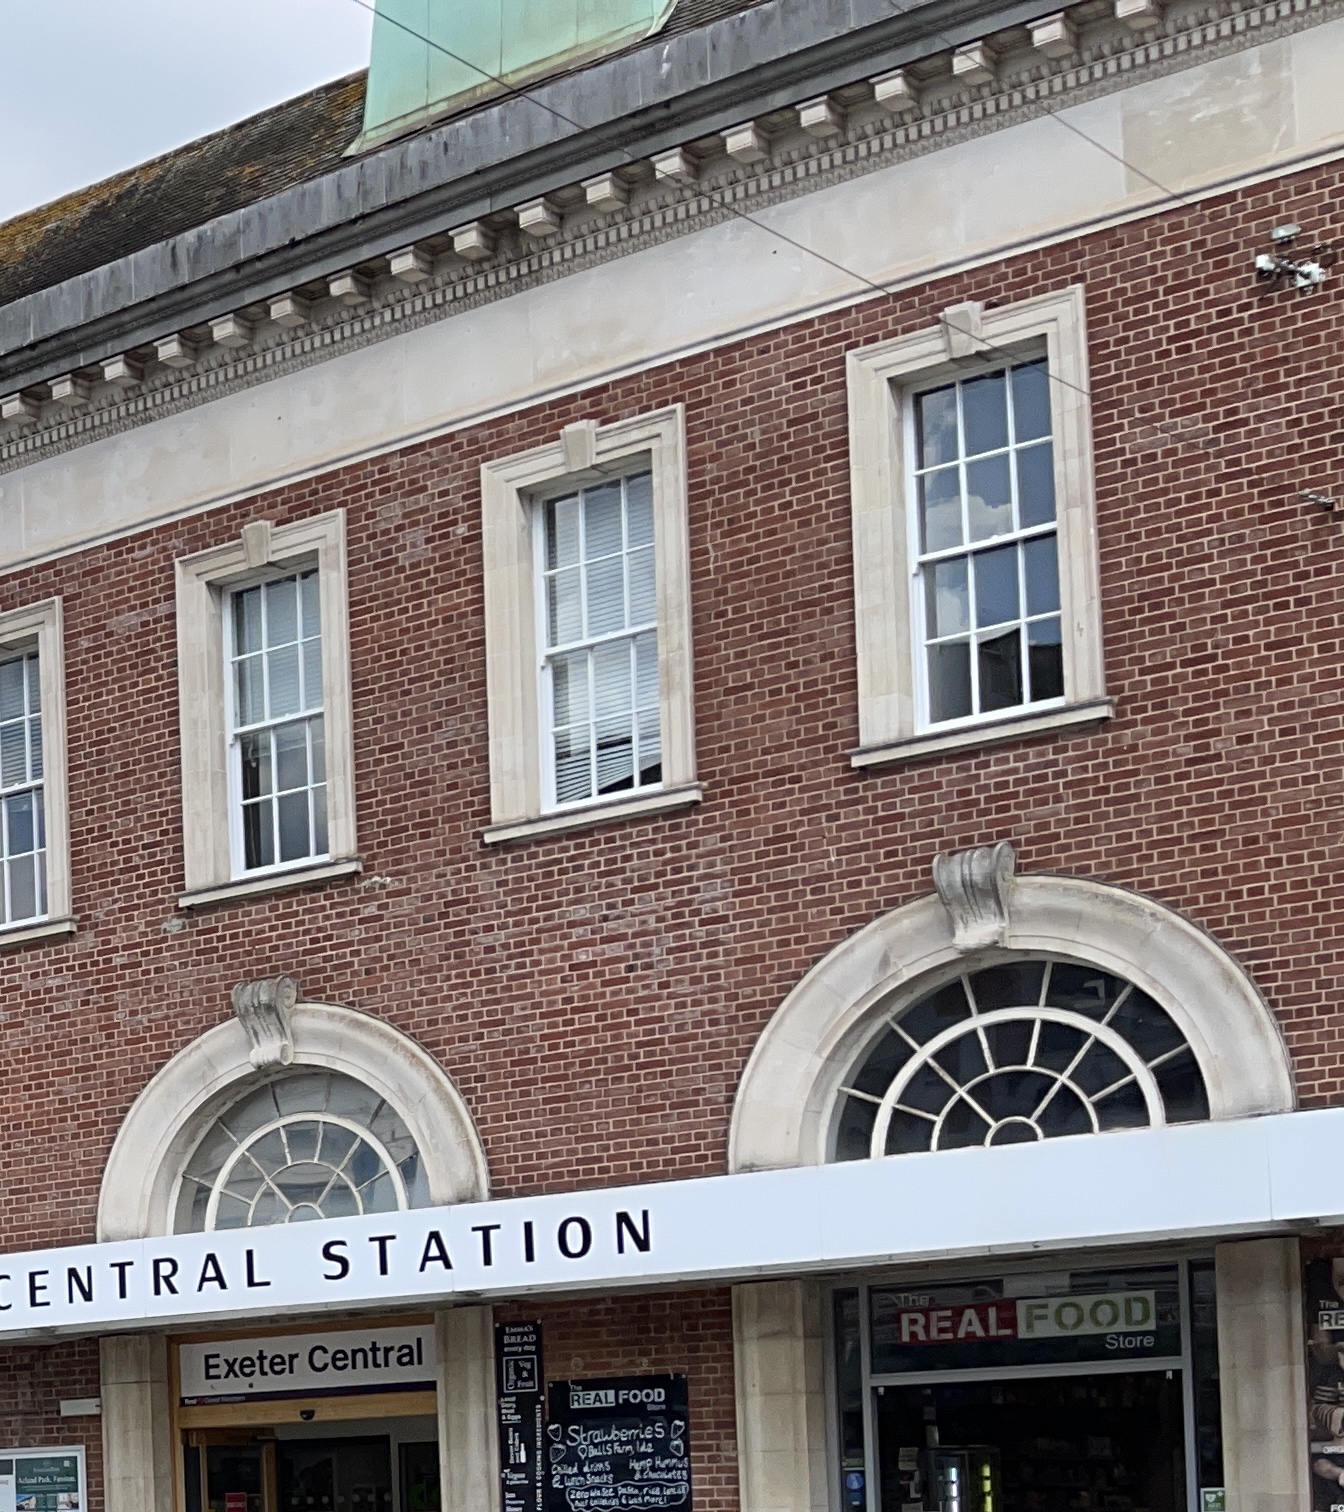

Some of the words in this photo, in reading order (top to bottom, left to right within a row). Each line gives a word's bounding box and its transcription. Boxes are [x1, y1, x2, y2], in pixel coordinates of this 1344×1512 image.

[321, 1209, 651, 1281] STATION
[900, 1306, 1013, 1343] REAL
[1025, 1296, 1151, 1334] FOOD
[503, 1334, 537, 1344] BREAD
[1104, 1334, 1155, 1350] Store
[204, 1349, 300, 1380] Exeter
[308, 1337, 423, 1373] Central
[571, 1391, 615, 1407] REAL
[618, 1388, 666, 1404] FOOD
